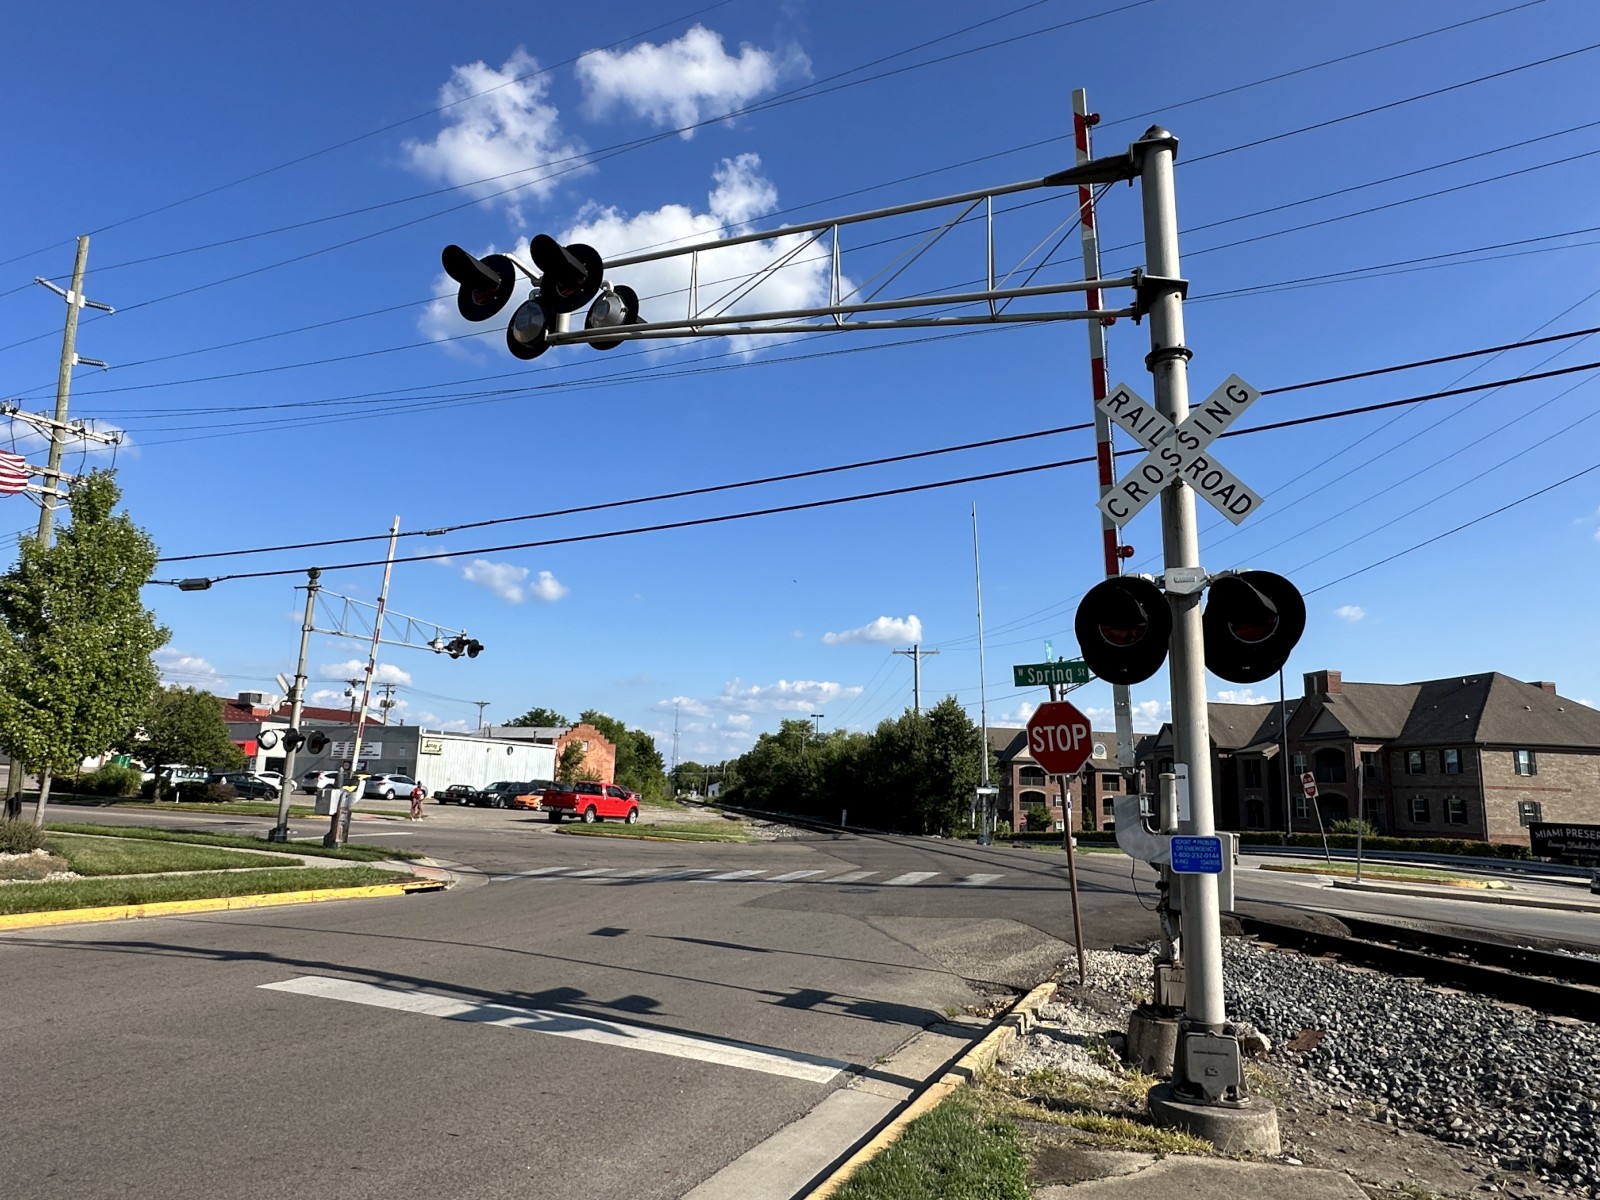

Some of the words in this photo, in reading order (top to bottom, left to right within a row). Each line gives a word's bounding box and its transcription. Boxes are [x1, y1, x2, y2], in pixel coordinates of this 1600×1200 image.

[1107, 385, 1249, 518] CROSSING
[1107, 390, 1166, 447] RAIL
[1184, 456, 1252, 515] ROAD
[1017, 668, 1024, 677] W
[1027, 666, 1073, 685] Spring
[1077, 668, 1085, 677] St
[1032, 723, 1087, 753] STOP
[1534, 828, 1563, 838] MIAMI
